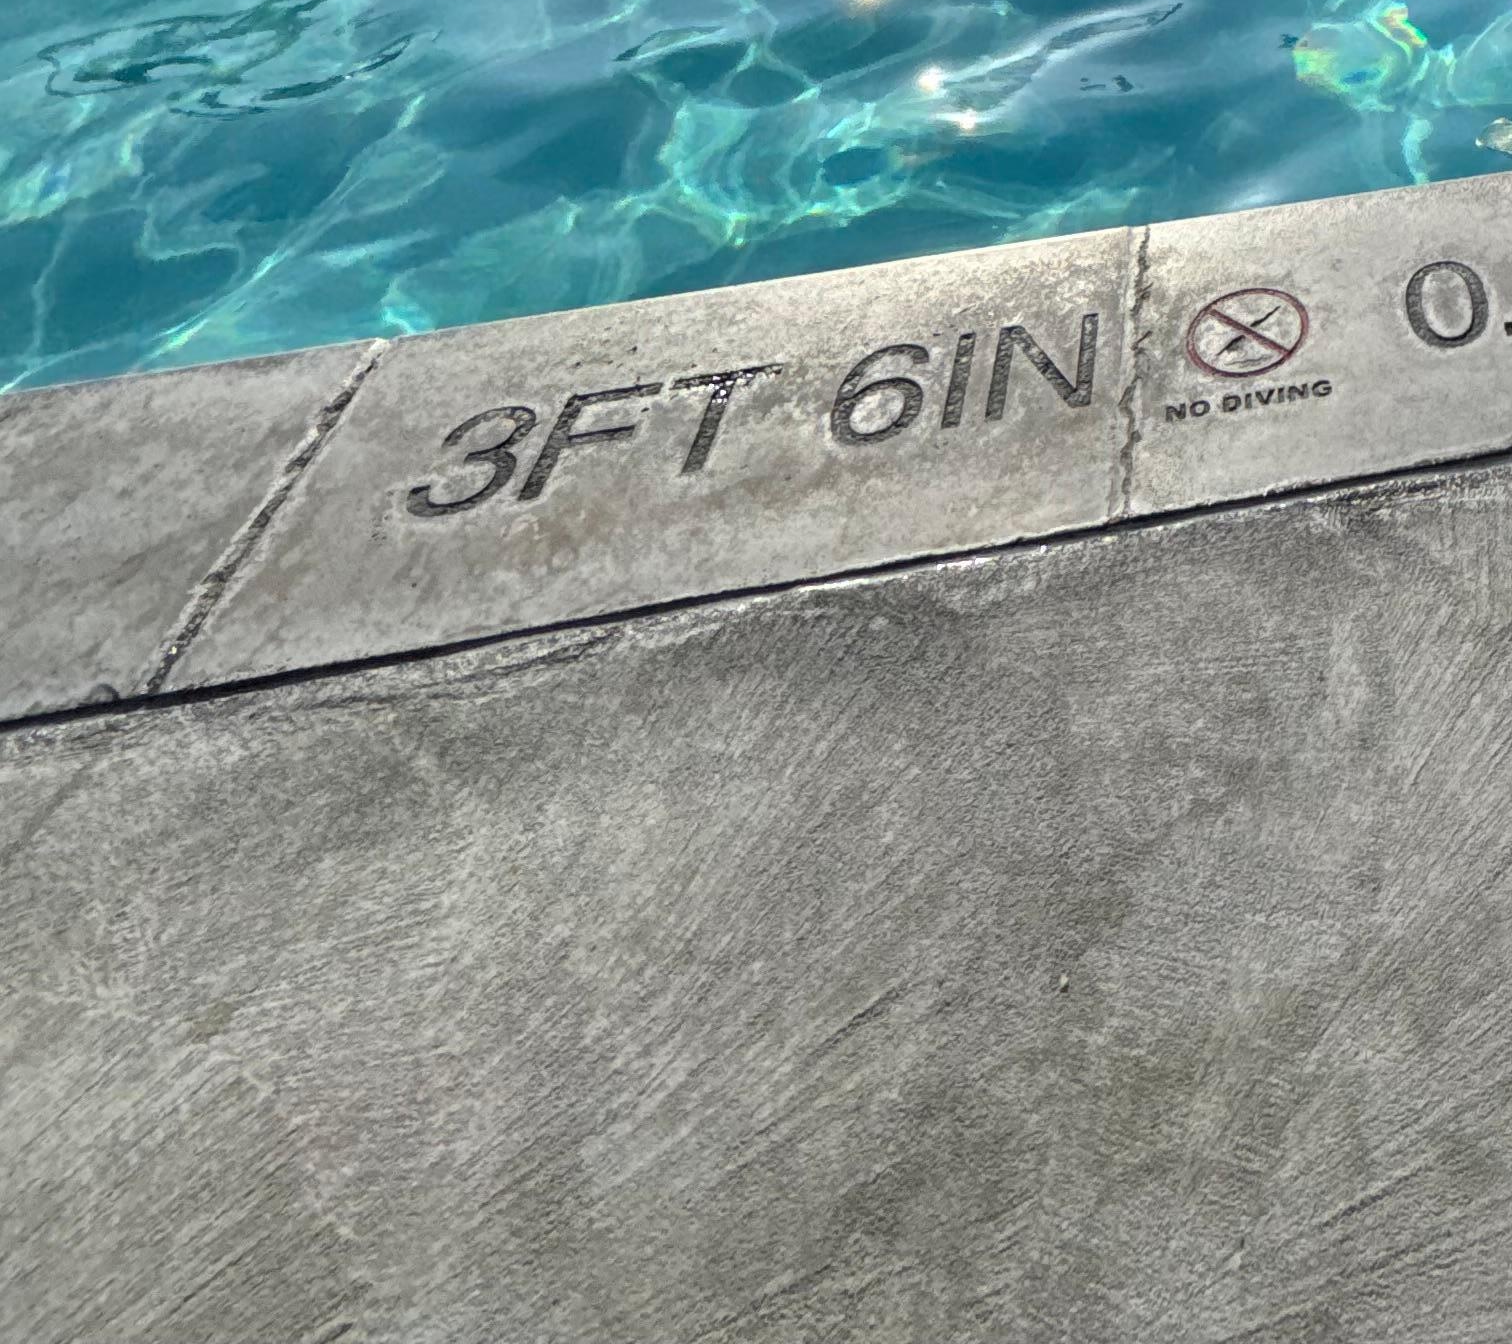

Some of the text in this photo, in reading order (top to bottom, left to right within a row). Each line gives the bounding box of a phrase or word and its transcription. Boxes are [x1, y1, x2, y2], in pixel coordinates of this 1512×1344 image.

[405, 312, 1099, 517] 3FT 6IN
[1165, 379, 1333, 423] NO DIVING
